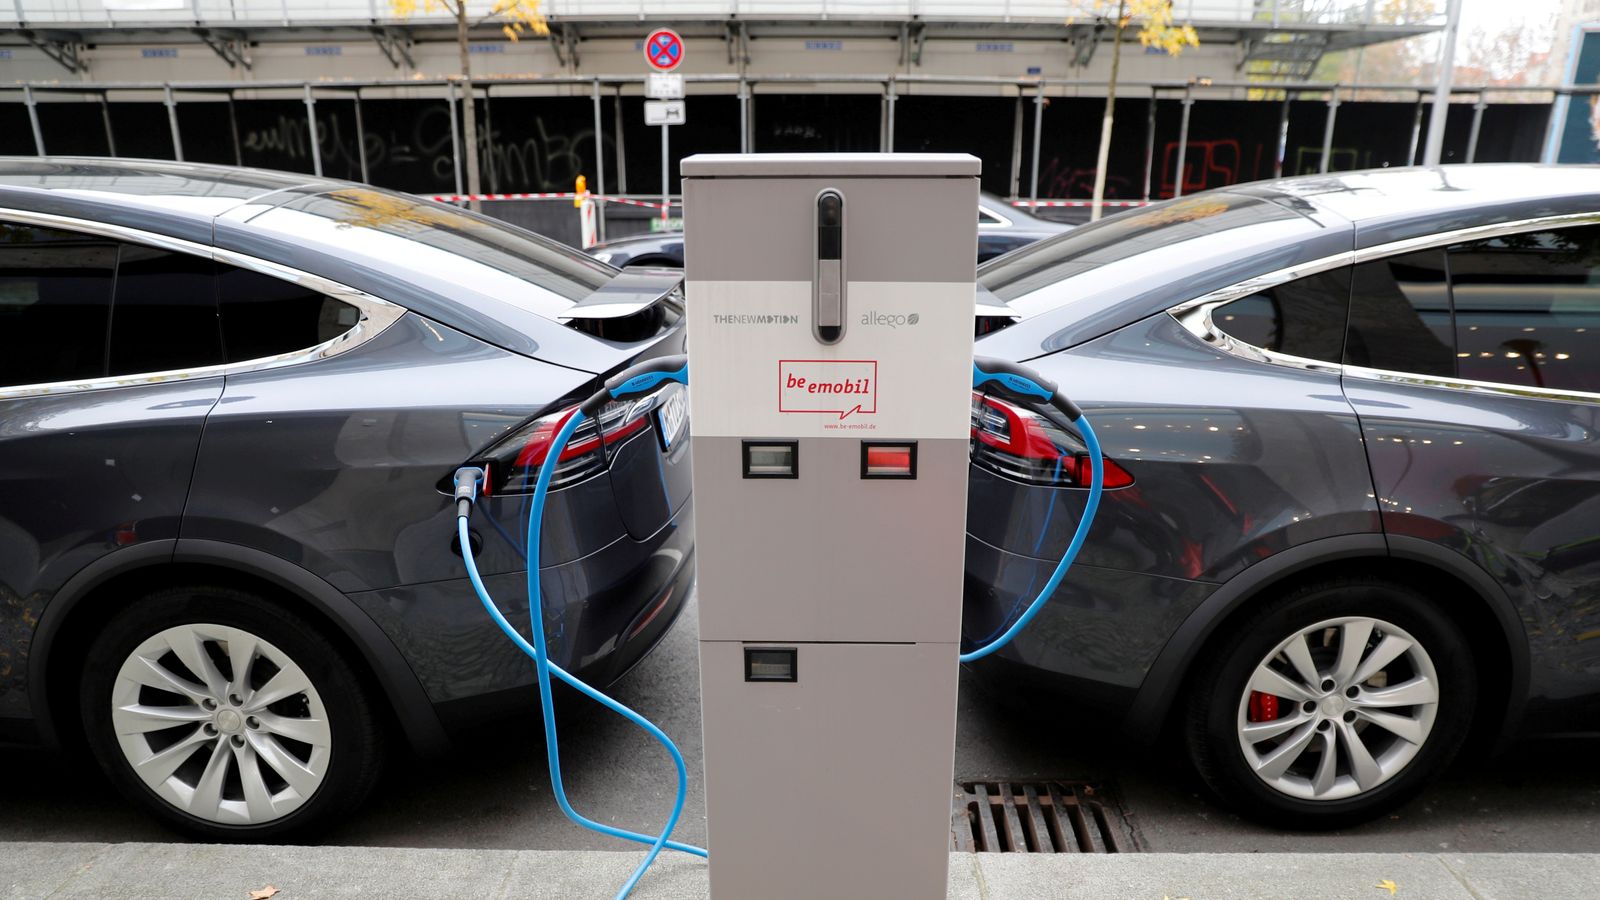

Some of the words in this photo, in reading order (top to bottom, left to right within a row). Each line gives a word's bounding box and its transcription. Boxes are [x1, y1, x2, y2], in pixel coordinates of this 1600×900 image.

[861, 310, 906, 329] allego
[786, 372, 806, 389] be
[808, 377, 870, 395] emobil
[823, 422, 877, 431] www.be-emobil.de
